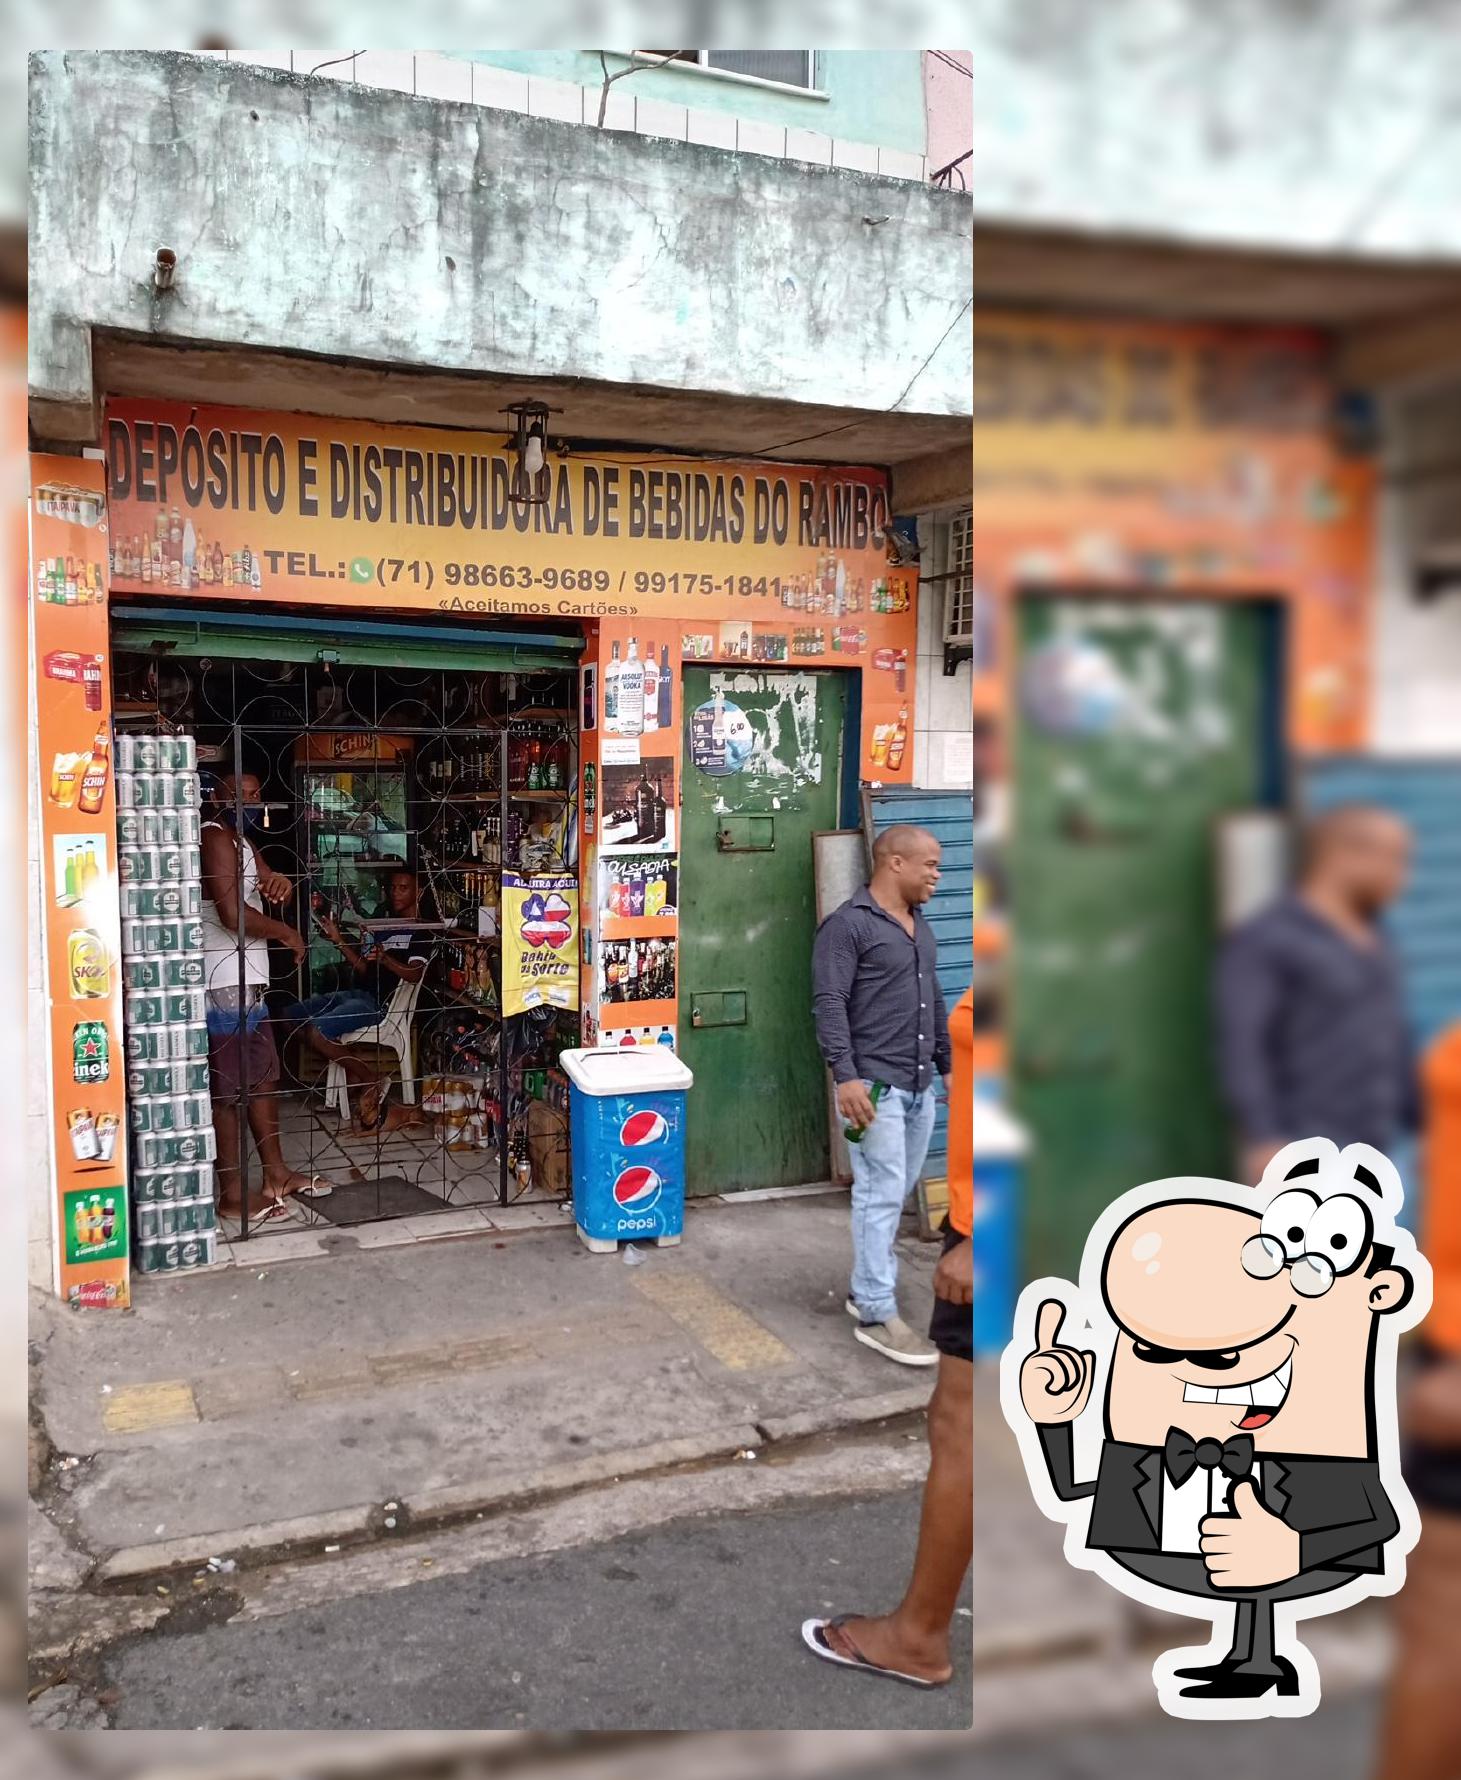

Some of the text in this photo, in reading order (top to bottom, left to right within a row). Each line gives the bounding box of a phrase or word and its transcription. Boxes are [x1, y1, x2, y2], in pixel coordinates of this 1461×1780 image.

[108, 407, 888, 551] DEPÓSITO E DISTRIBUIDORA DE BEBIDAS DO RAMBO
[263, 550, 346, 579] TEL.:
[376, 557, 435, 590] (71)
[444, 562, 610, 592] 98663-9689
[633, 571, 781, 597] 99175-1841
[82, 775, 106, 788] SCHIN
[531, 962, 570, 977] Sorte
[617, 1215, 657, 1232] pepsi
